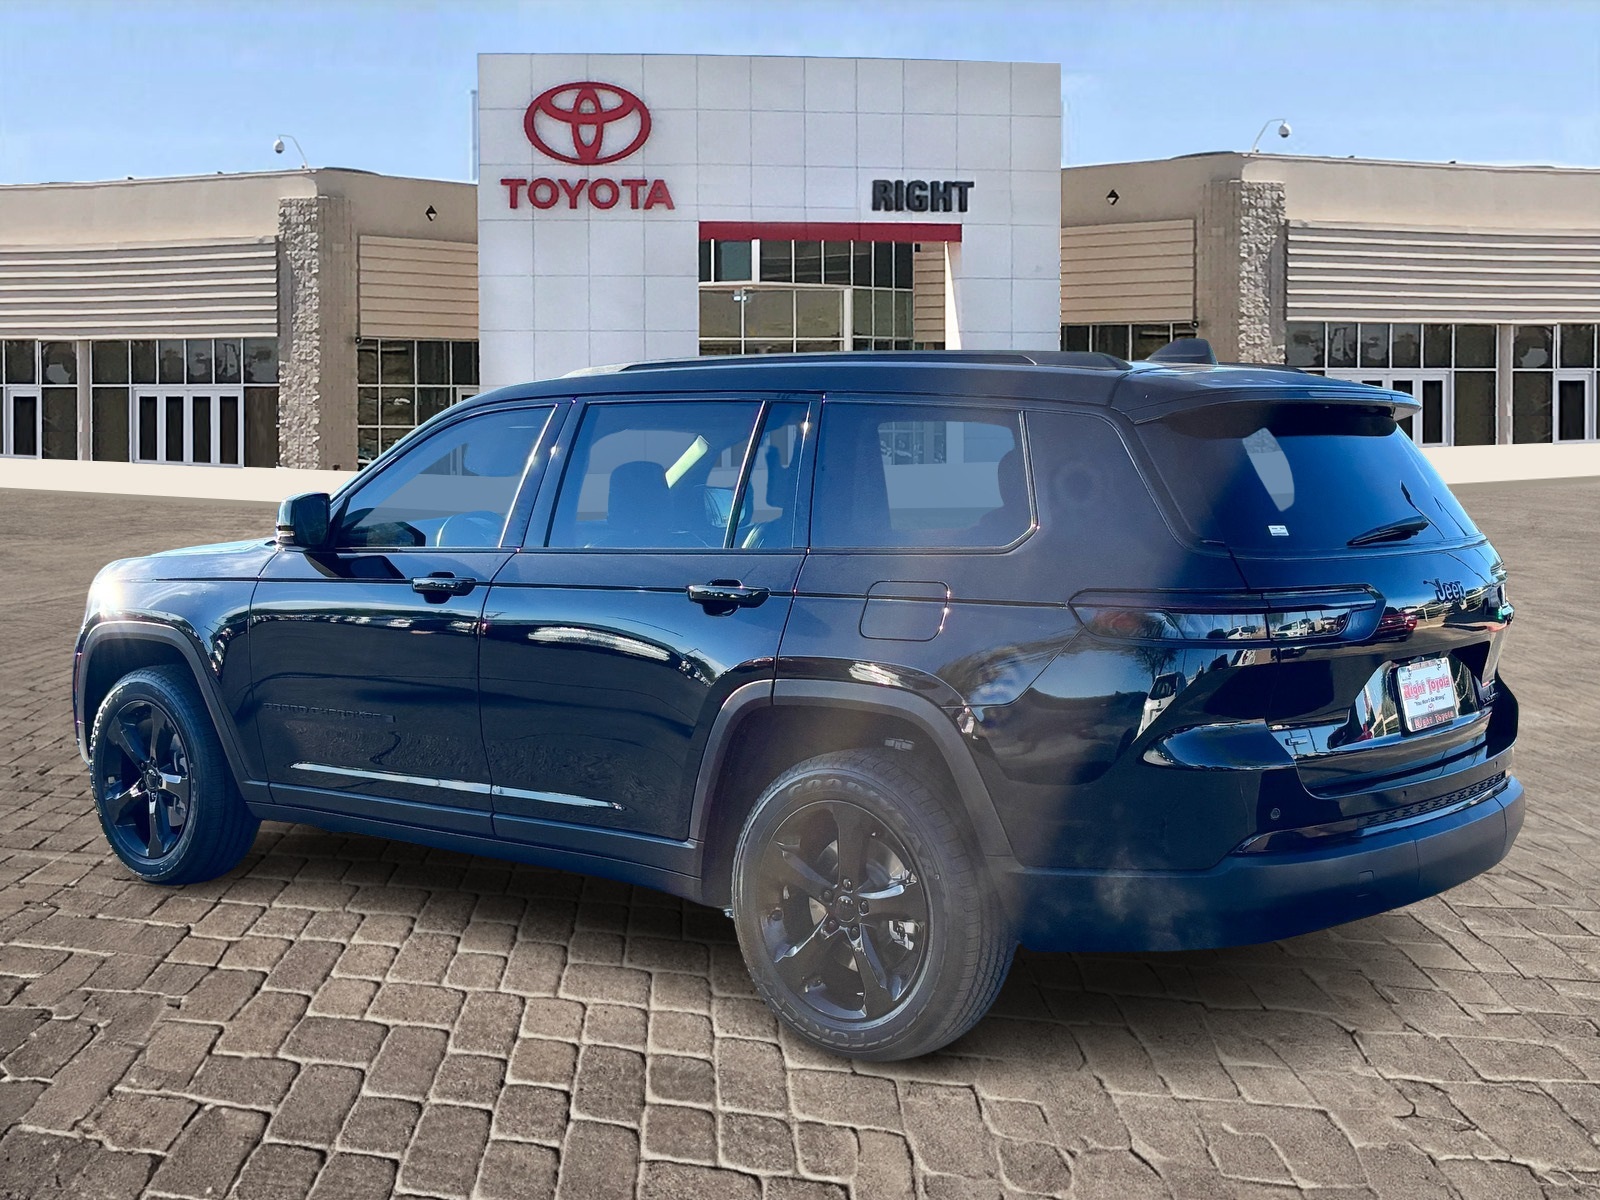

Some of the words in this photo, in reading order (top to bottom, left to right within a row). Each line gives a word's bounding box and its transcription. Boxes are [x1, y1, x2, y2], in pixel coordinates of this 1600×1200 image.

[500, 177, 675, 210] TOYOTA
[872, 179, 975, 212] RIGHT
[1435, 580, 1466, 605] Jeep
[1403, 681, 1426, 700] Right
[1426, 676, 1451, 694] Toyota
